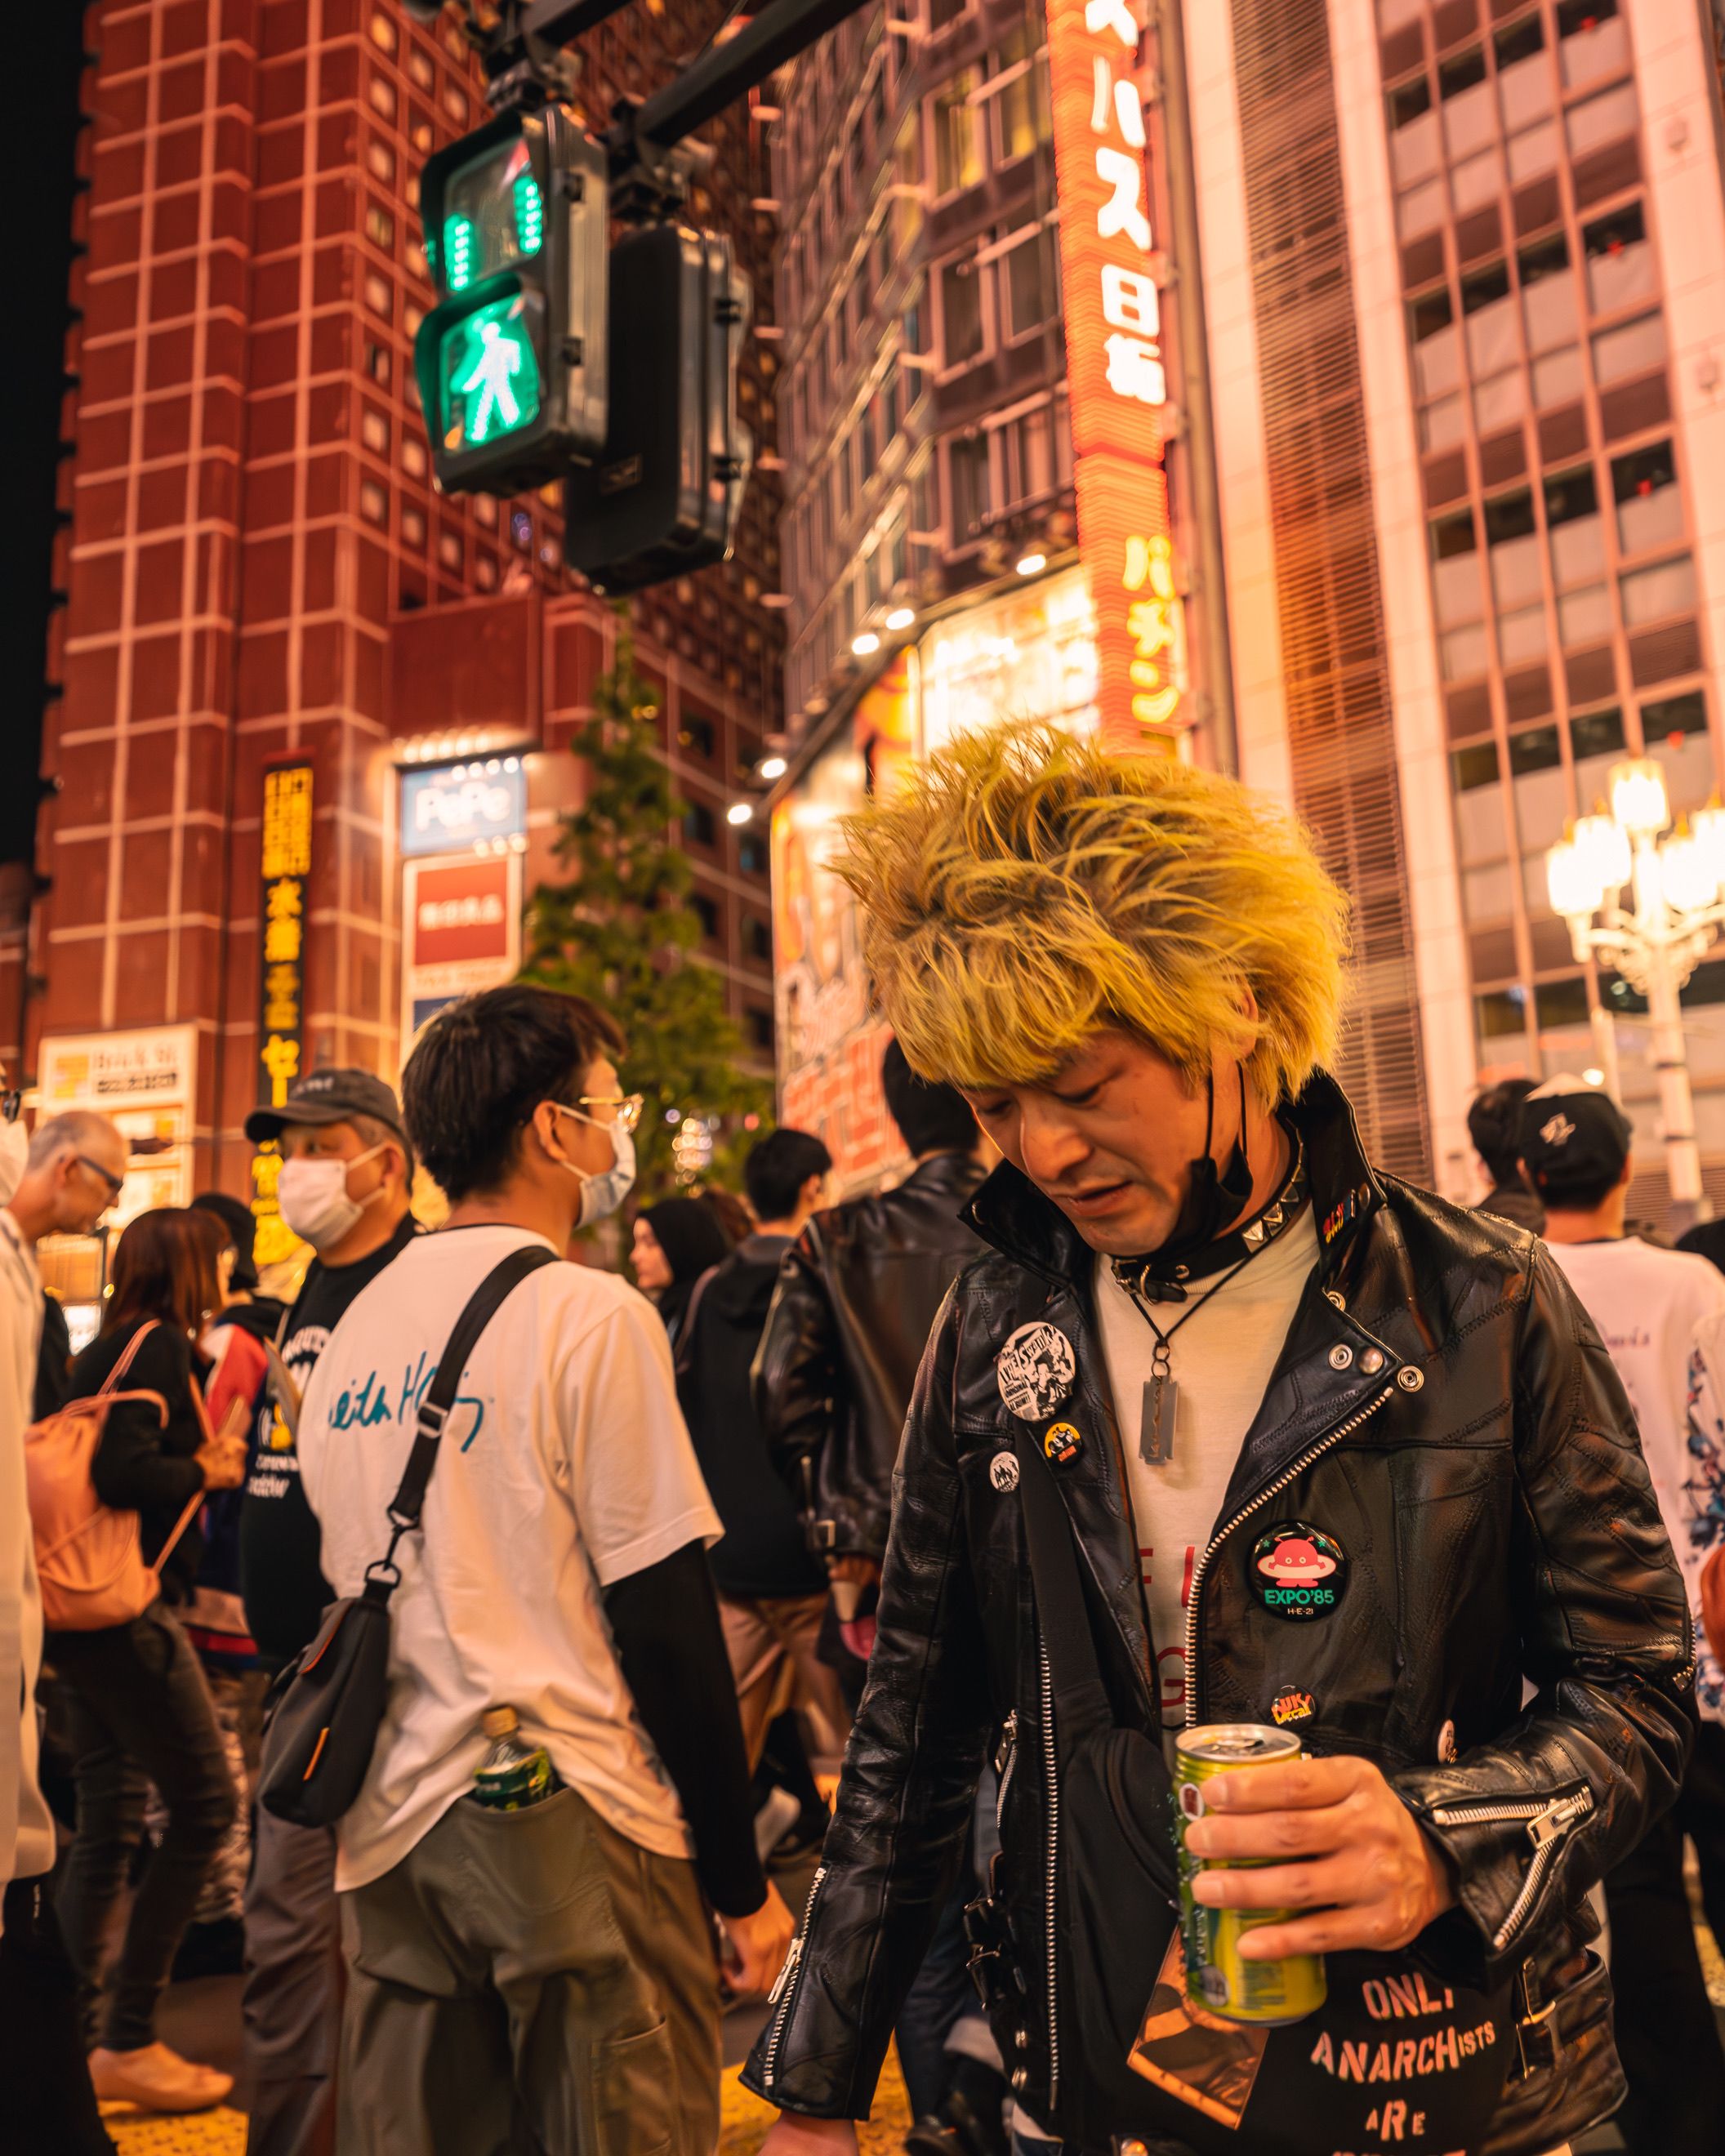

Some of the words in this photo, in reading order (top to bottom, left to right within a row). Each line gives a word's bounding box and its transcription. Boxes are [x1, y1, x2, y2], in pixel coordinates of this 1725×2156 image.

[328, 1370, 391, 1430] eith
[1264, 1588, 1335, 1605] EXPO'85
[1365, 2098, 1426, 2142] ARE
